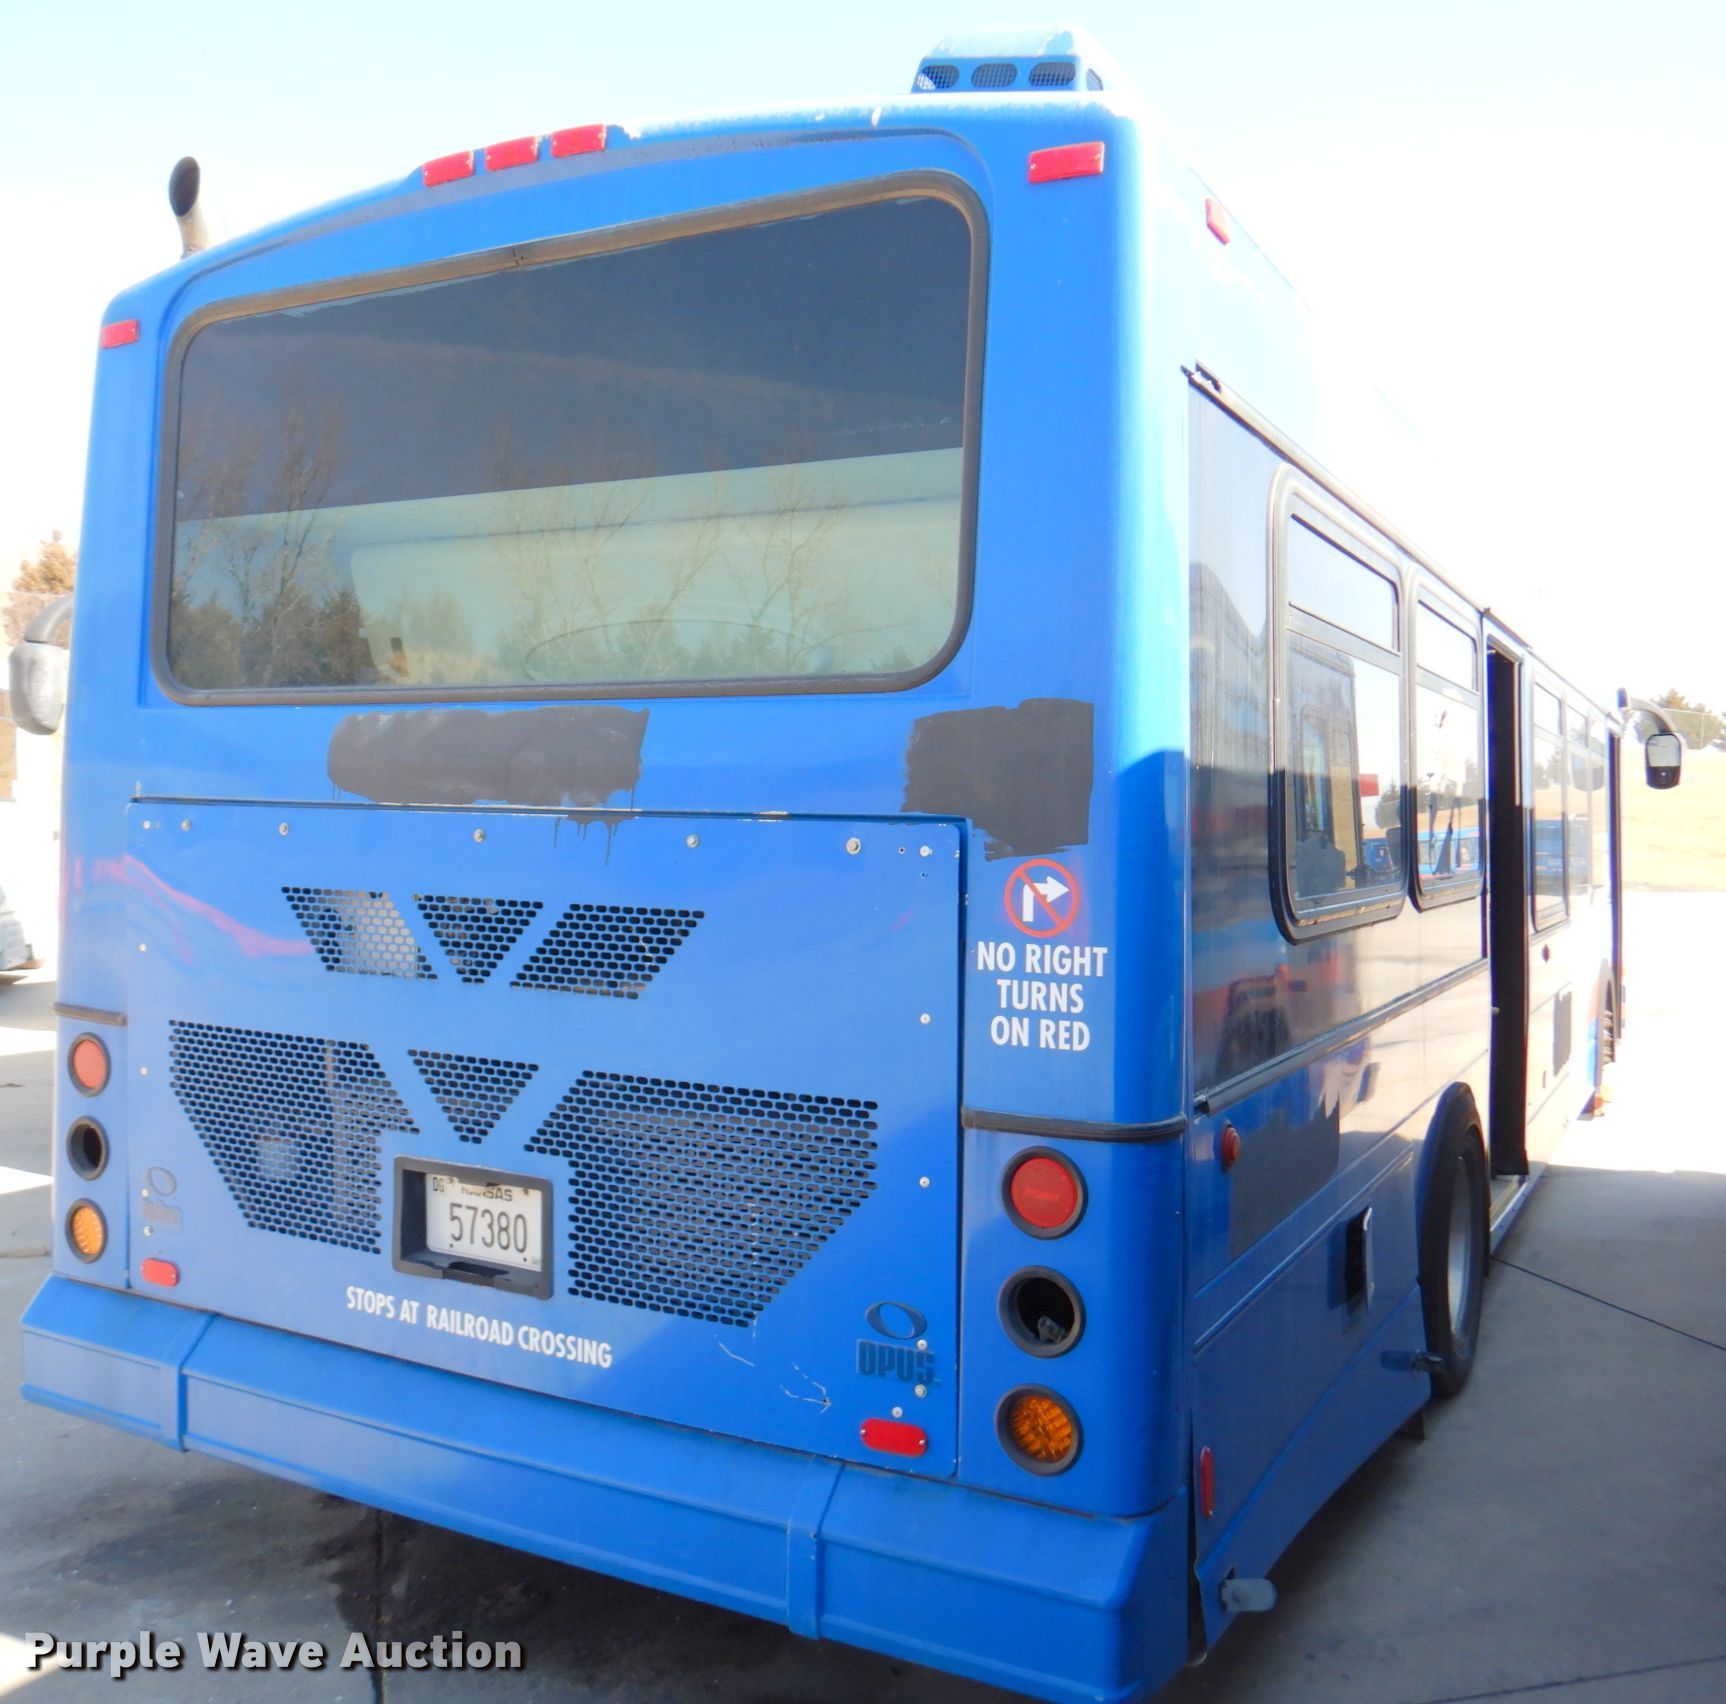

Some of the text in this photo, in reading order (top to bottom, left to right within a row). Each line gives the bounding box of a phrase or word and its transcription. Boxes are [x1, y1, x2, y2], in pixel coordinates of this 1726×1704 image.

[977, 941, 1108, 977] NO RIGHT
[997, 979, 1085, 1013] TURNS
[990, 1015, 1091, 1051] ON RED
[432, 1176, 445, 1193] DG
[460, 1186, 513, 1202] KSAS
[450, 1202, 528, 1253] 57380
[346, 1285, 613, 1368] STOPS AT RAILROAD CROSSING
[857, 1338, 936, 1385] OPUS
